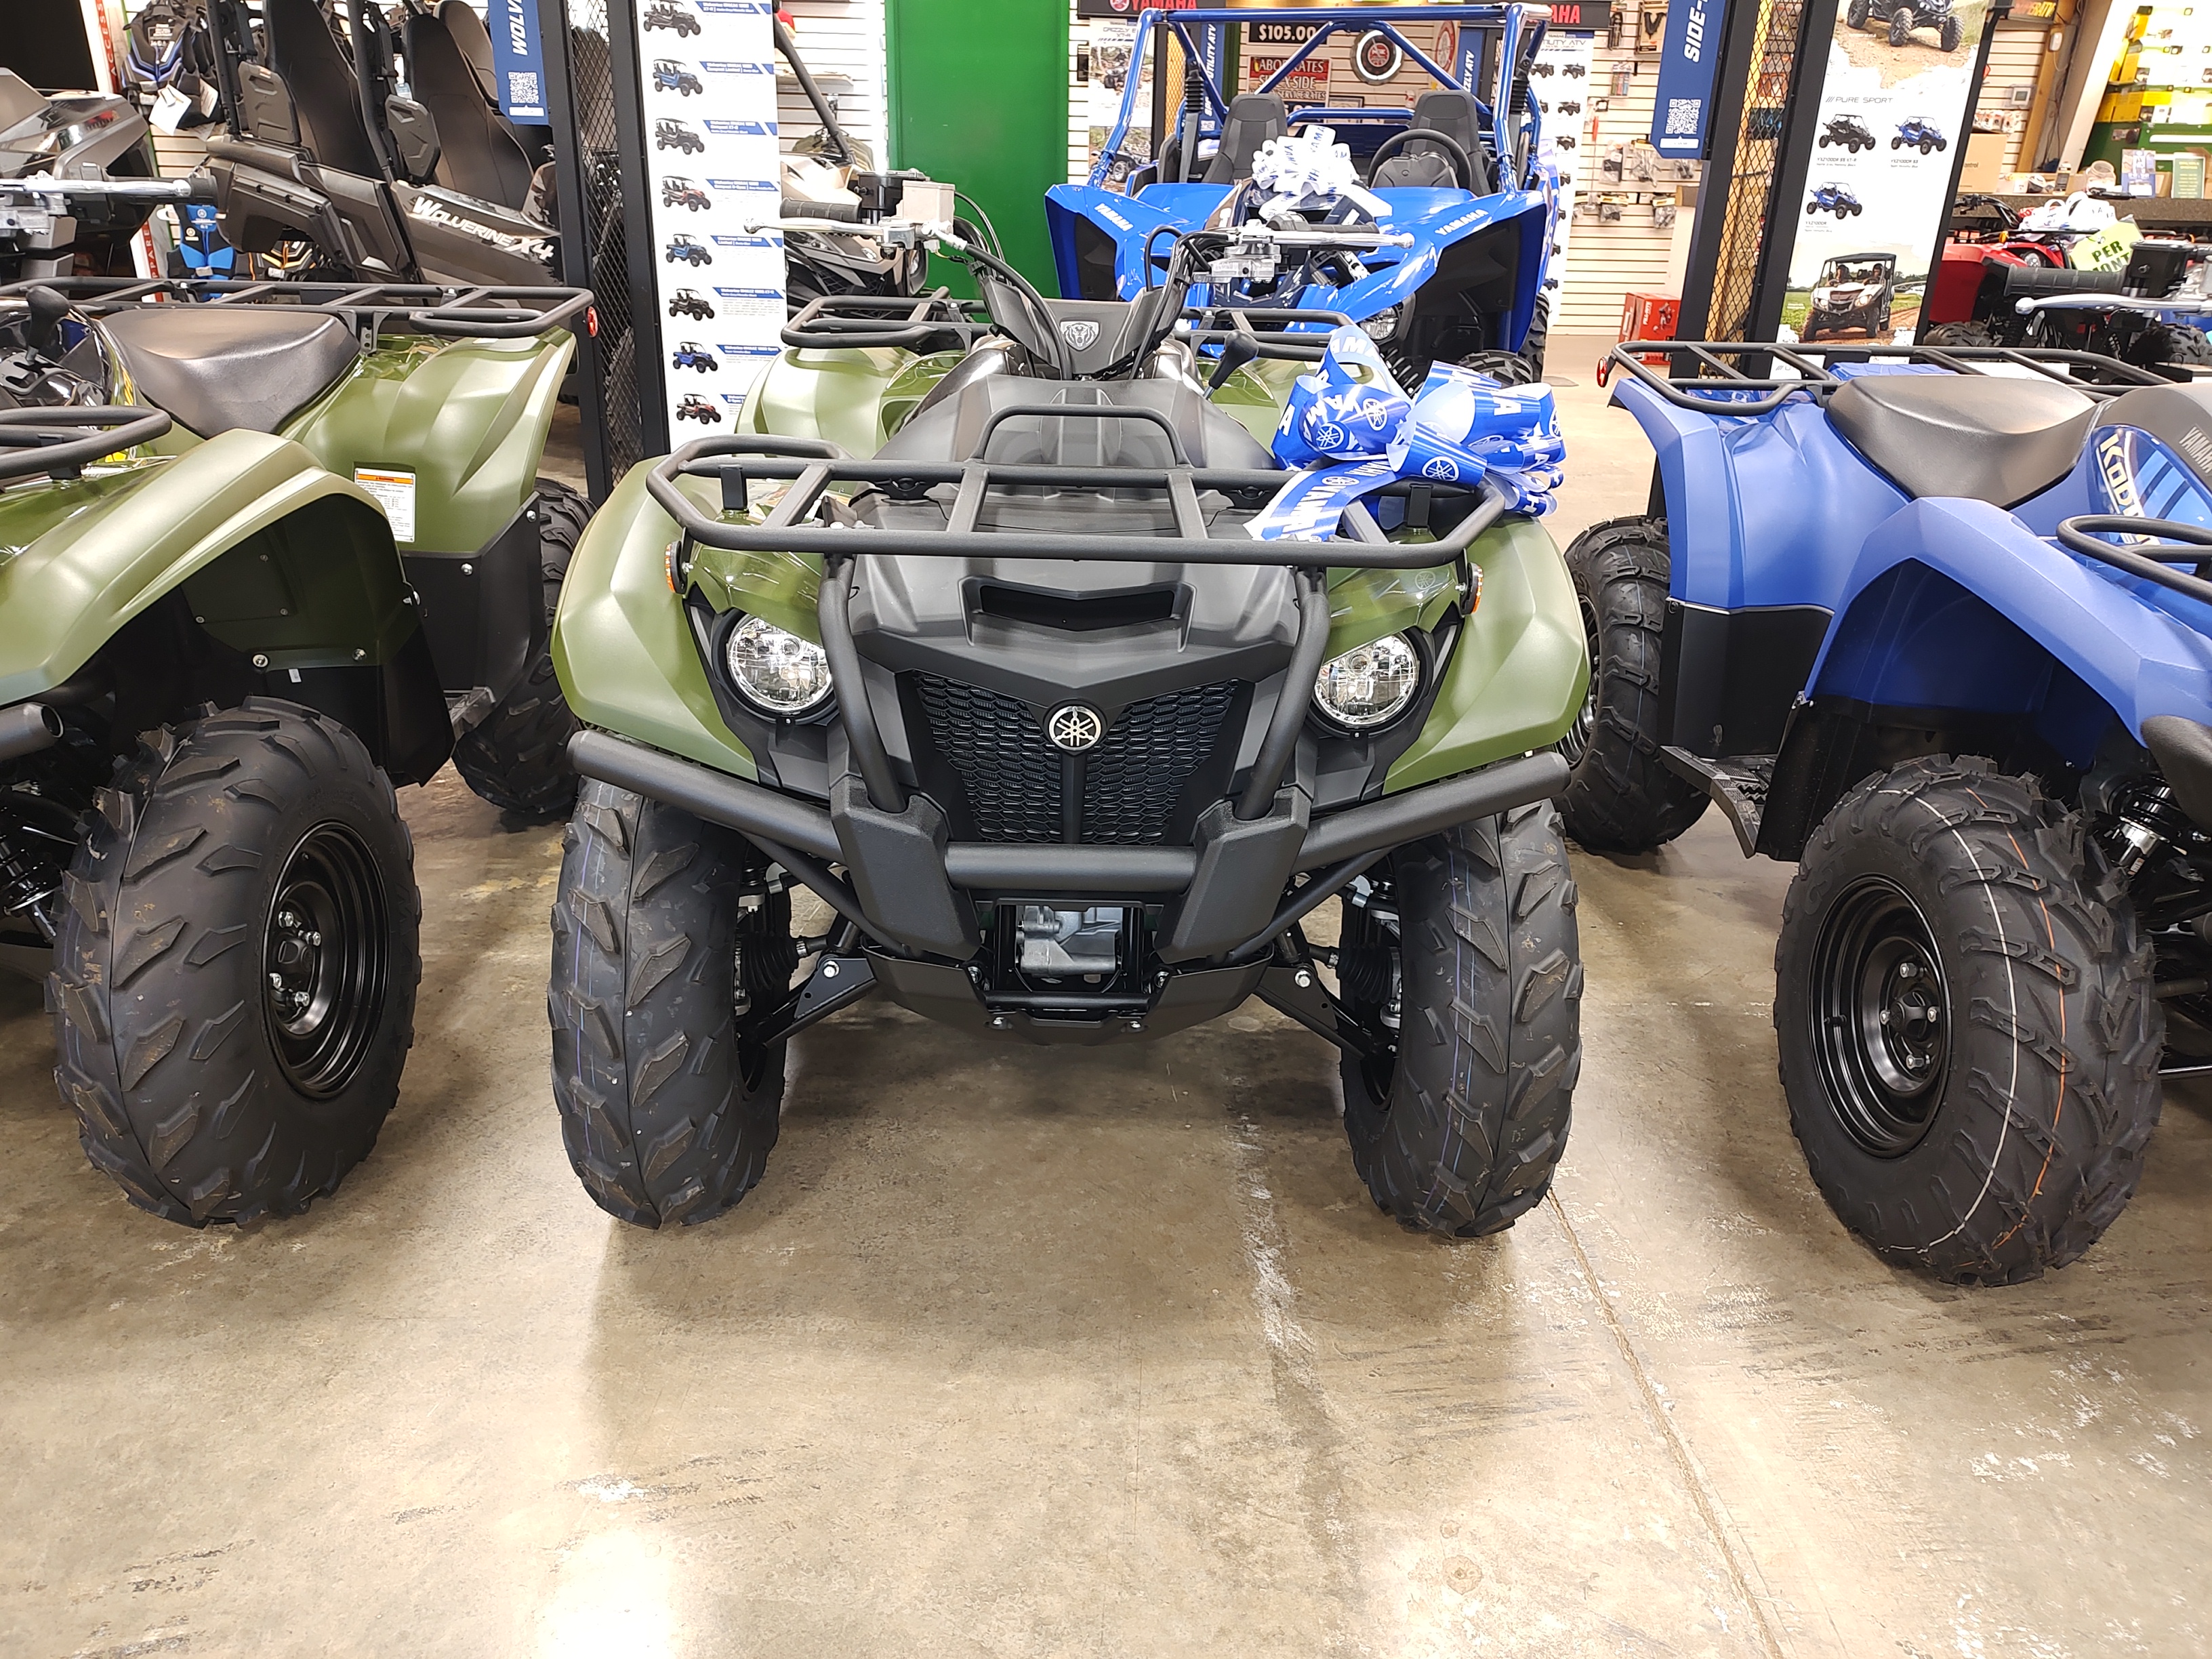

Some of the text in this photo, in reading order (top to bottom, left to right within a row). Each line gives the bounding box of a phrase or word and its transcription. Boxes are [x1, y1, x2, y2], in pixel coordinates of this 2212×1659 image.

[1208, 24, 1216, 43] ATV
[1684, 0, 1708, 63] SIDE-
[1466, 49, 1475, 72] ATV
[412, 196, 515, 247] WOLVERINE
[1094, 203, 1134, 232] YAMAHA
[1434, 209, 1490, 236] YAMAHA
[2091, 240, 2123, 263] PER
